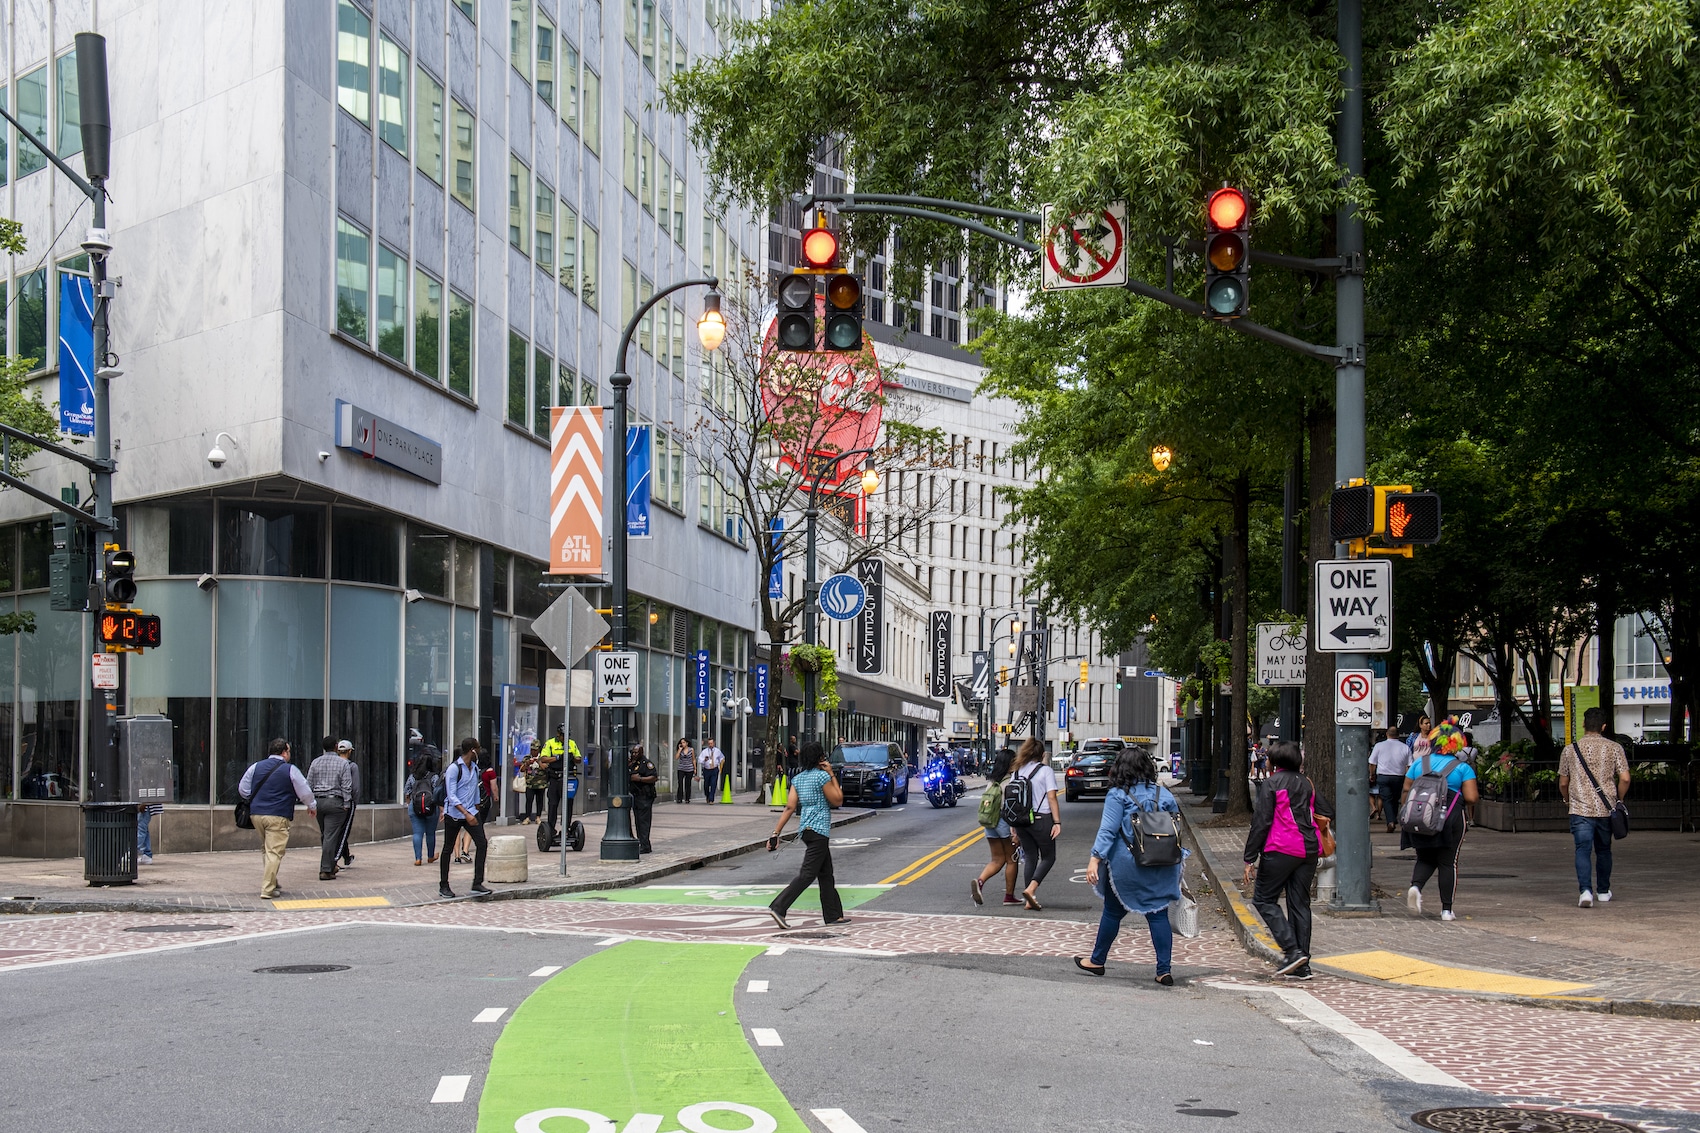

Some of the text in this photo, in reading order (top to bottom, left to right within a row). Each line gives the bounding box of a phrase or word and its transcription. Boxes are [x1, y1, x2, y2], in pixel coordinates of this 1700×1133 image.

[905, 377, 957, 397] UNIVERSITY
[885, 392, 905, 401] YOUNG
[378, 430, 433, 466] ONE PARK PLACE
[562, 535, 591, 549] ATL
[561, 549, 591, 563] DTN
[1330, 569, 1377, 589] ONE
[861, 561, 879, 671] WALGREENS
[1329, 597, 1378, 617] WAY
[122, 618, 134, 639] 12
[935, 613, 949, 695] WALGREENS
[1266, 655, 1286, 666] MAY
[604, 657, 631, 670] ONE
[603, 673, 631, 686] WAY
[1261, 669, 1286, 679] FULL
[698, 662, 707, 707] POLICE
[1349, 680, 1363, 697] P
[1622, 686, 1636, 700] 34
[758, 675, 766, 715] POLICE
